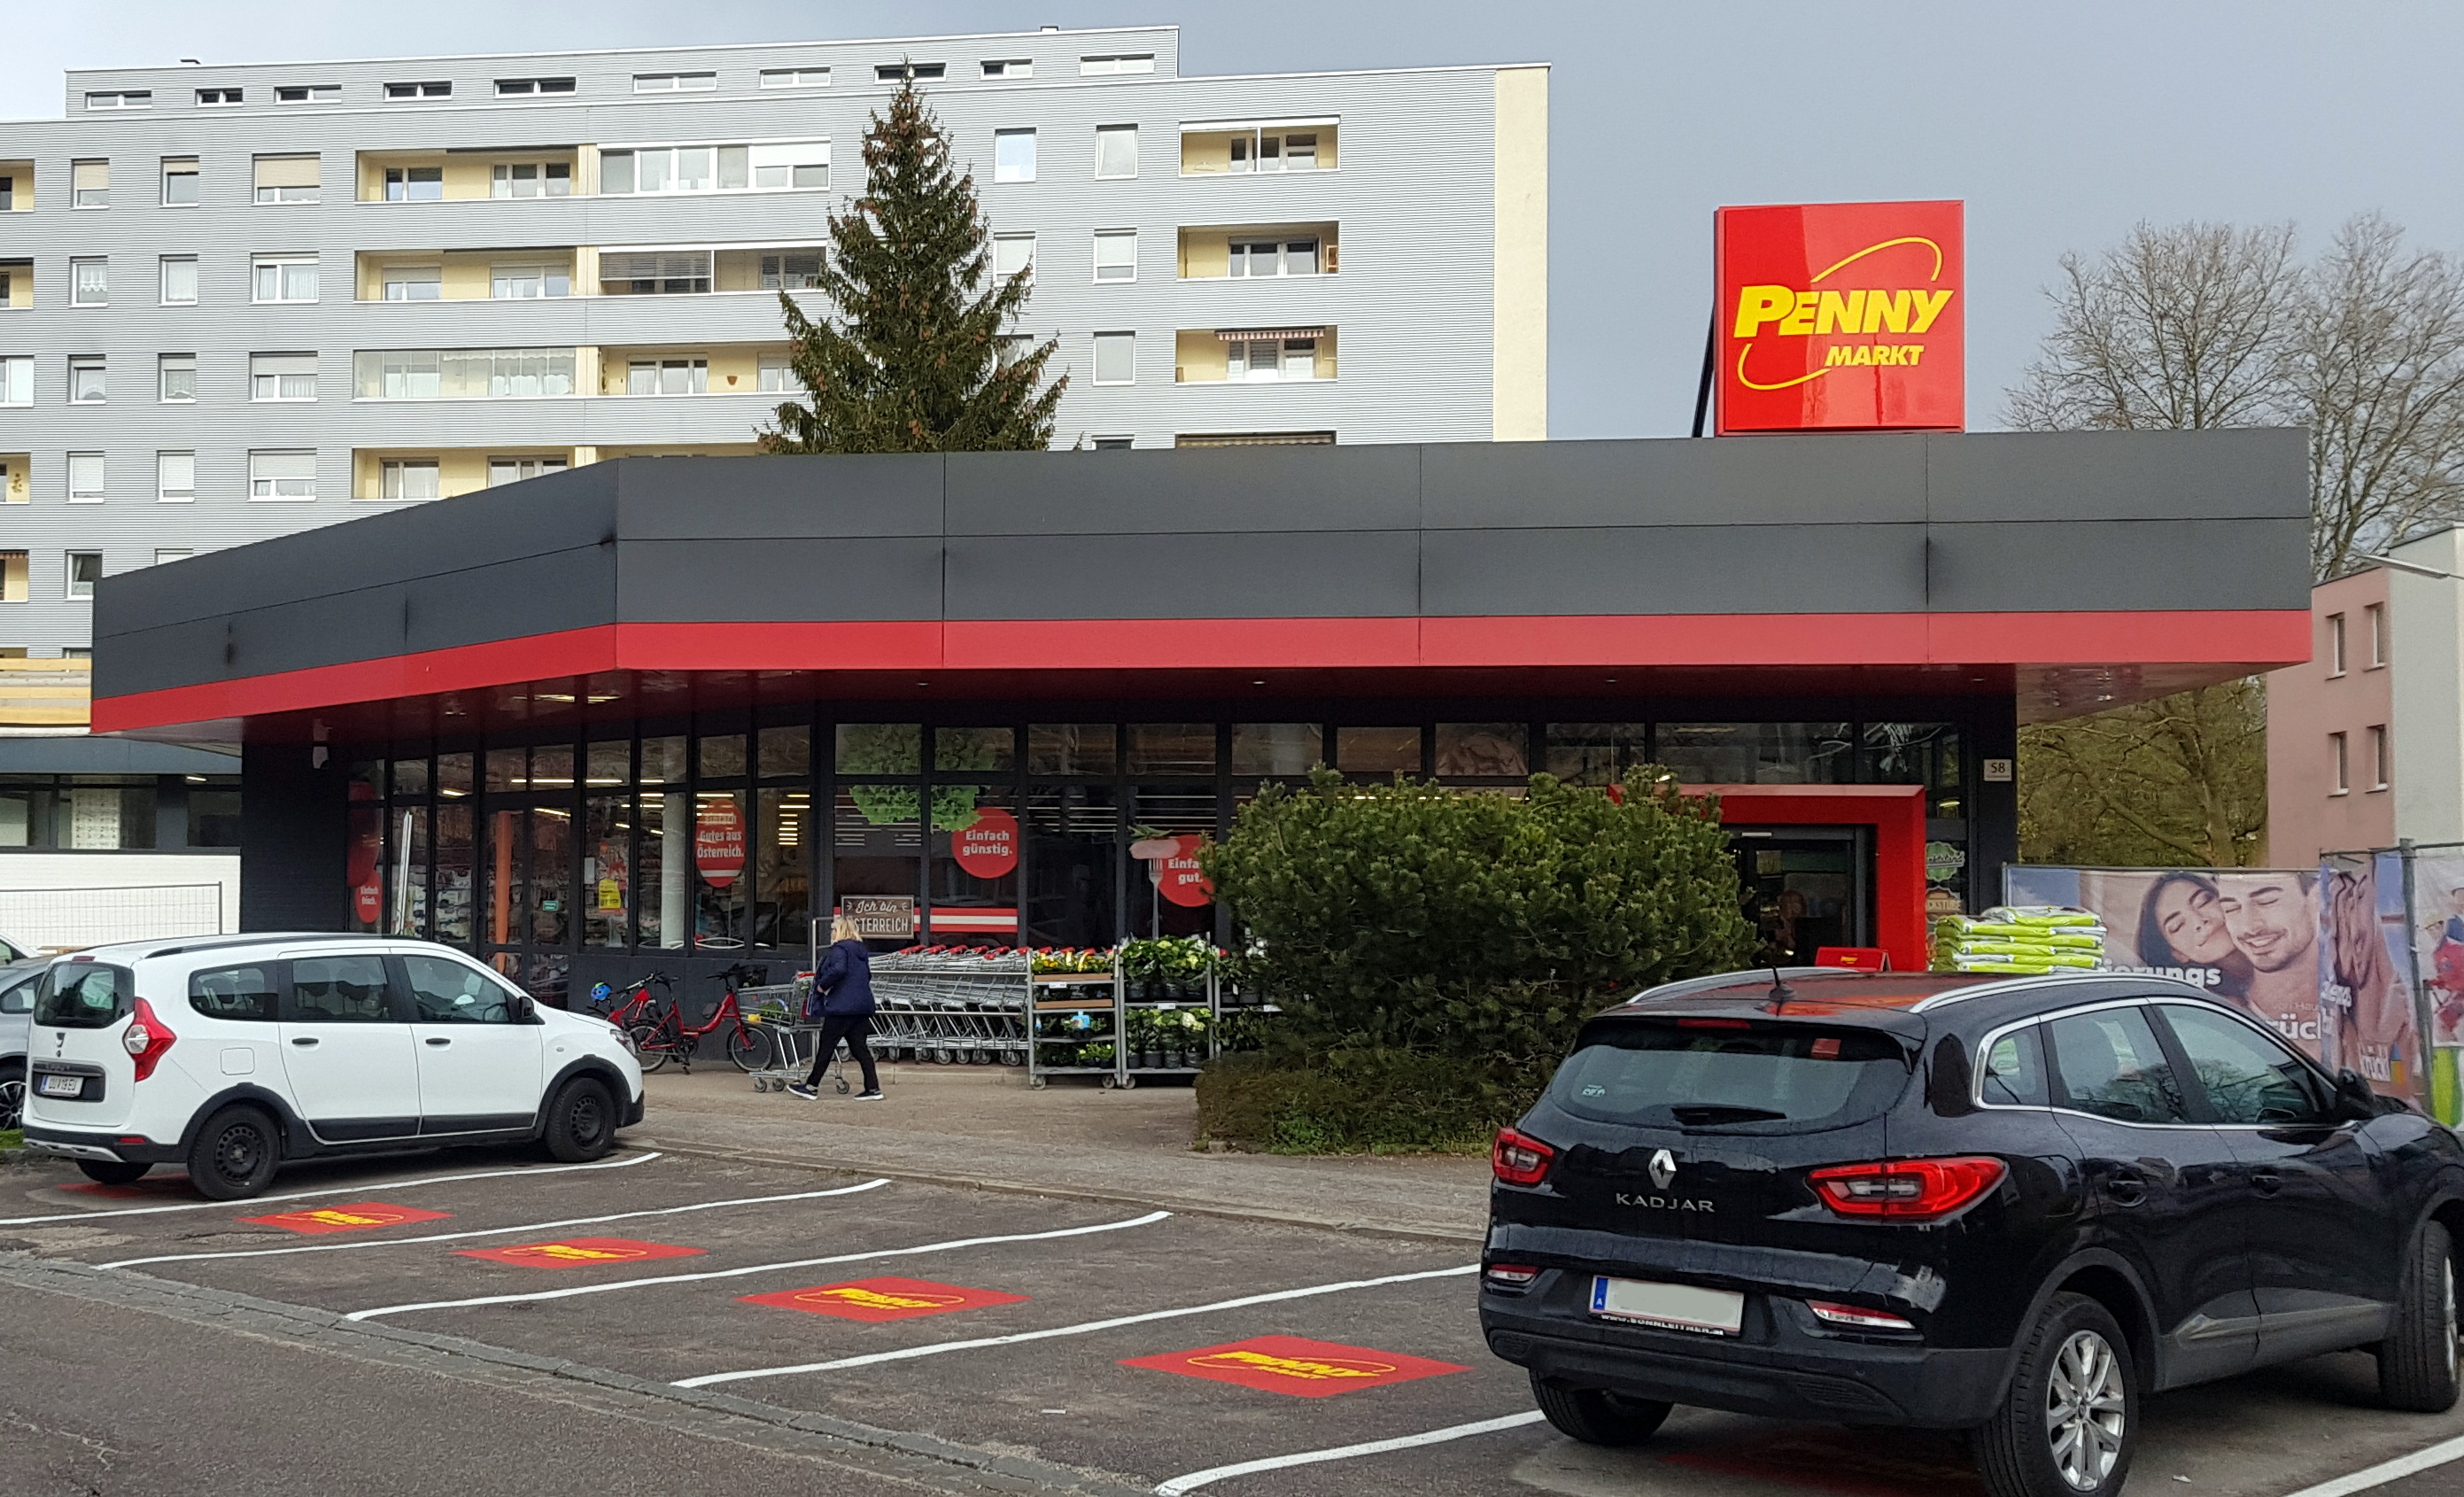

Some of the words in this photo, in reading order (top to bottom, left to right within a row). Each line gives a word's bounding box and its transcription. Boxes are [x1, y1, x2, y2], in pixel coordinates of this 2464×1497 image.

[1733, 284, 1954, 338] PENNY
[1825, 345, 1925, 367] MARKT
[1990, 762, 2006, 774] 58
[700, 831, 724, 842] Gutes
[725, 831, 742, 842] aus
[965, 829, 1010, 842] Einfach
[697, 843, 745, 858] Österreich.
[962, 842, 1013, 857] günstig.
[1168, 857, 1202, 869] Einfa
[1178, 873, 1204, 885] gut.
[856, 900, 878, 914] Ich
[879, 901, 899, 913] bin
[854, 917, 910, 933] STERREICH
[1616, 1192, 1716, 1213] KADJAR
